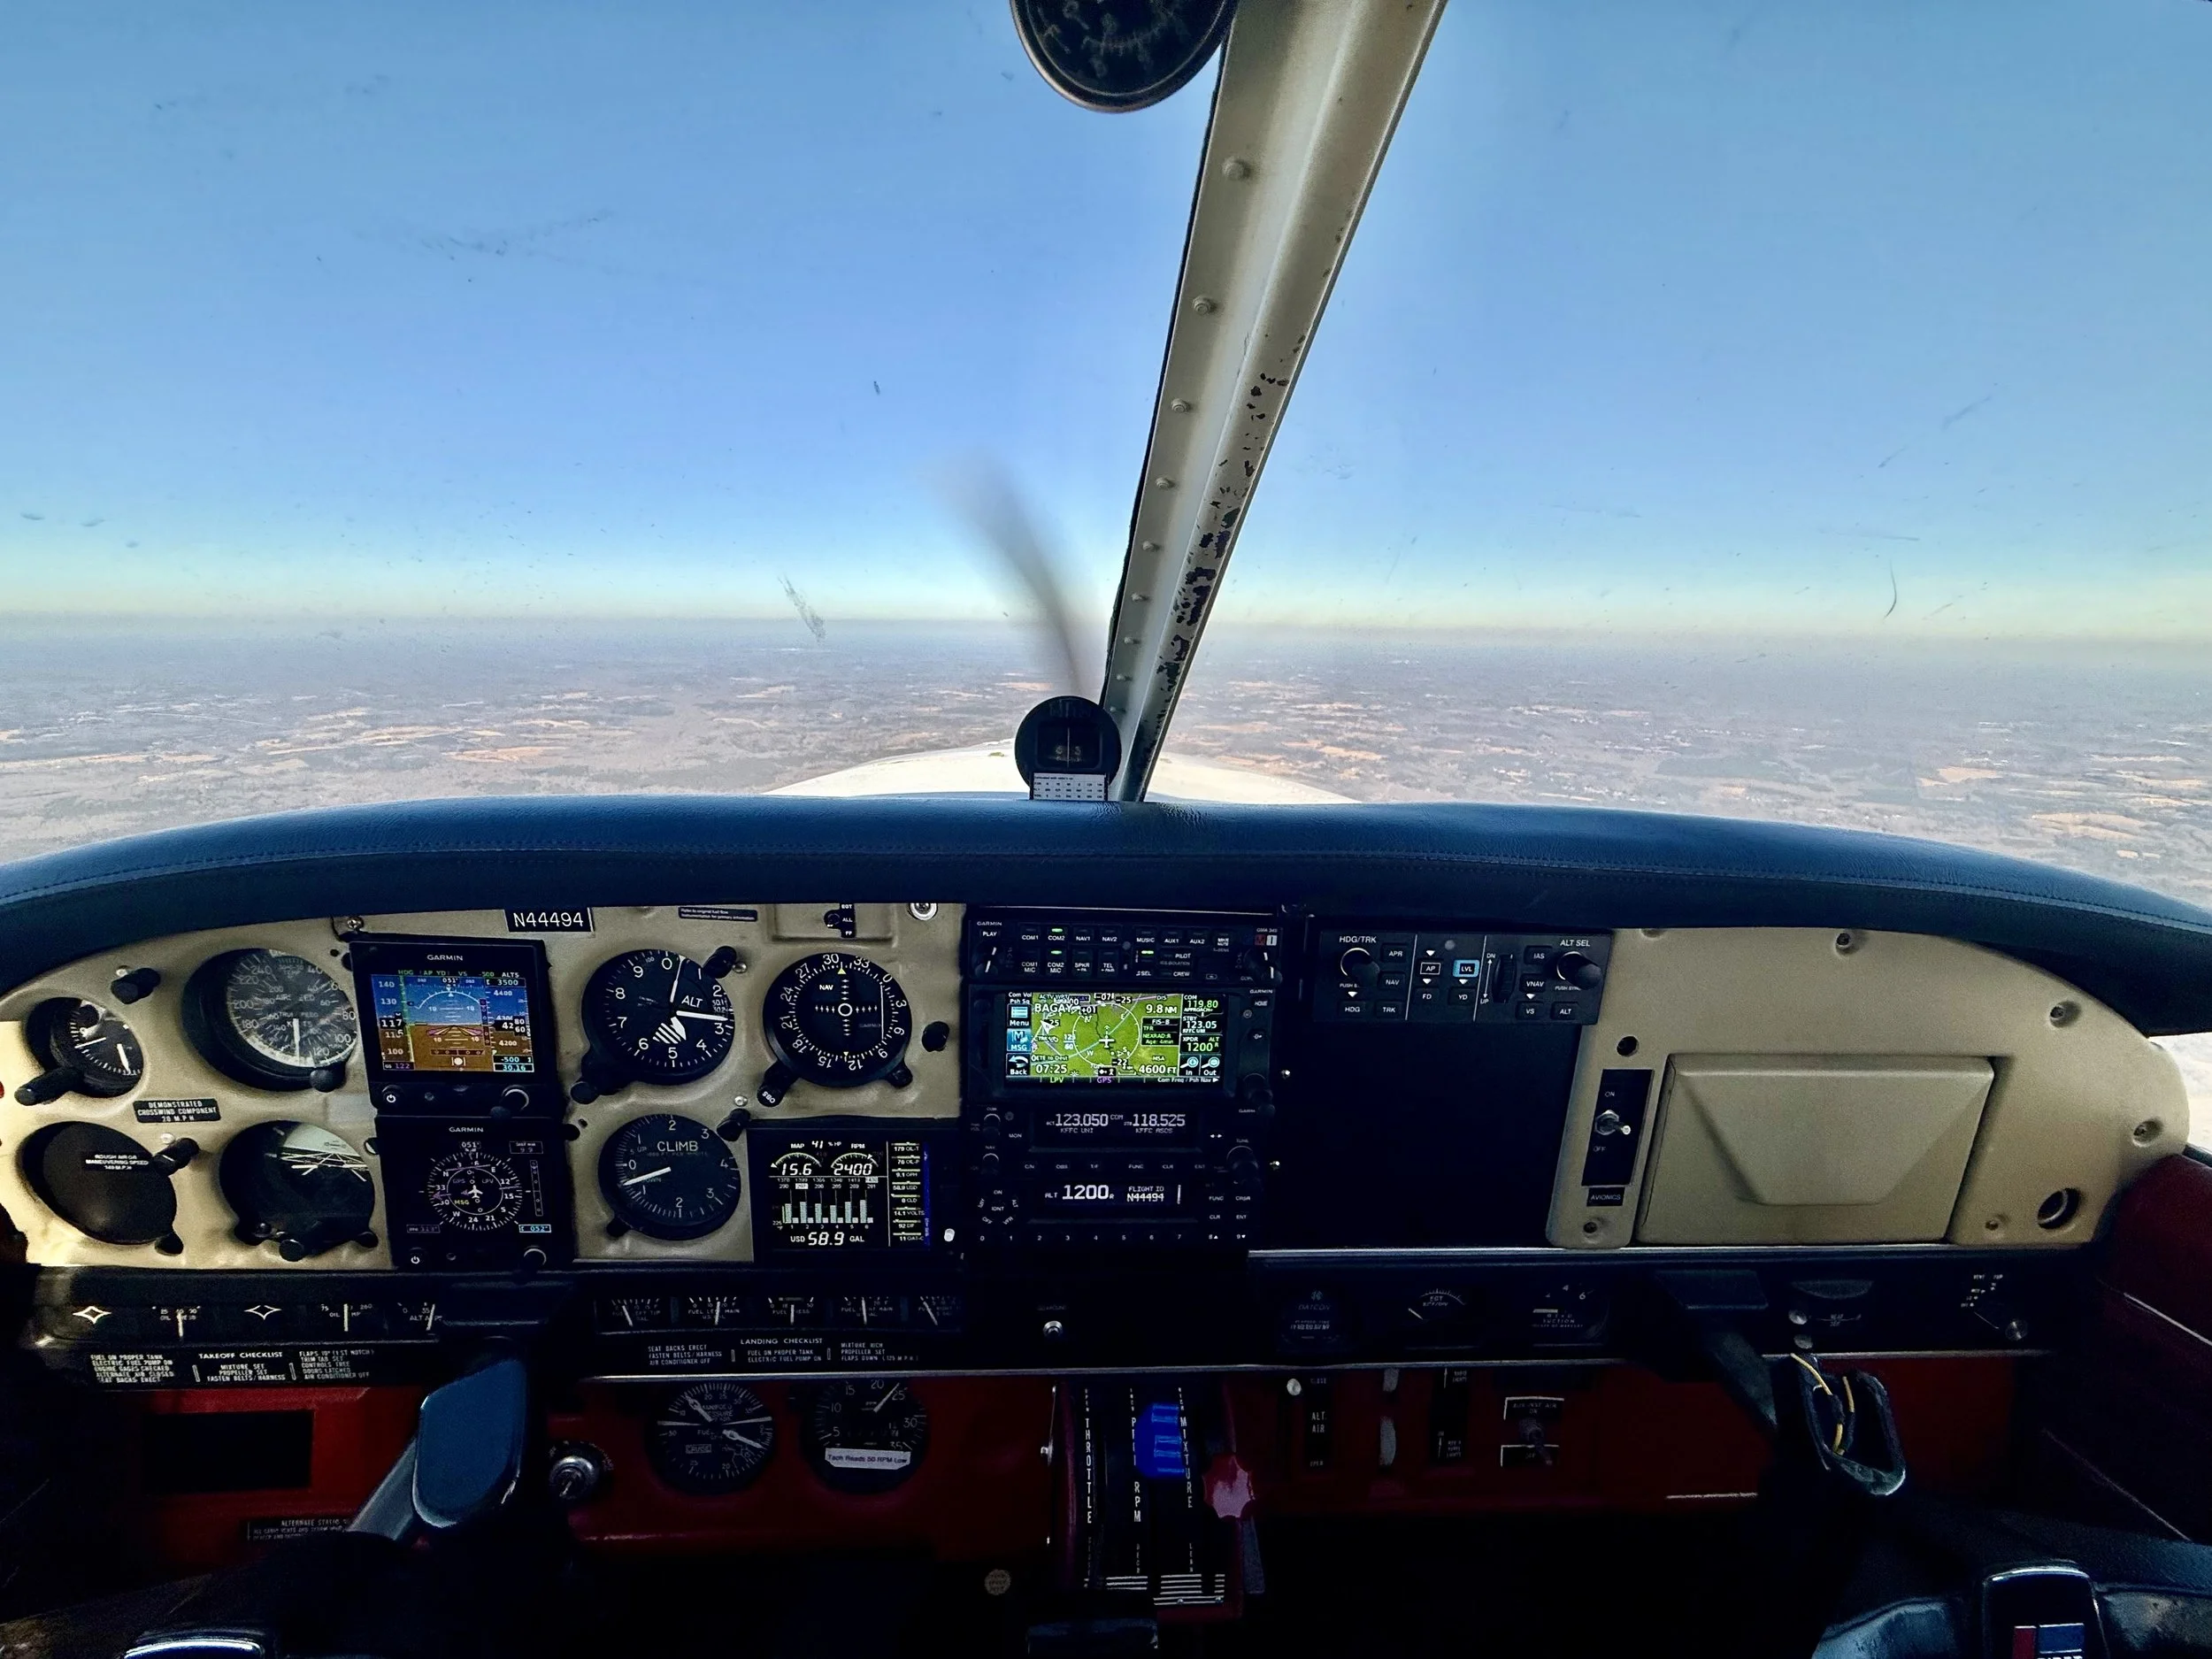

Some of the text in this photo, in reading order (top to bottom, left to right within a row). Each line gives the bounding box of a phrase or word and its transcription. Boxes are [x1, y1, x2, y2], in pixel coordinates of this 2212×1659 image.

[513, 912, 584, 927] N44494
[662, 958, 672, 970] 0
[823, 954, 839, 964] 30
[854, 956, 871, 968] 33
[634, 966, 643, 978] 9
[795, 964, 810, 978] 27
[615, 987, 626, 999] 8
[712, 985, 722, 996] 2
[780, 987, 794, 1002] 24
[681, 995, 703, 1008] ALT
[1146, 1004, 1163, 1013] 9.8
[618, 1017, 627, 1028] 7
[781, 1016, 793, 1029] 21
[715, 1023, 724, 1034] 3
[639, 1038, 649, 1049] 6
[696, 1040, 706, 1050] 4
[792, 1040, 808, 1054] 18
[668, 1047, 678, 1058] 5
[818, 1056, 832, 1068] 15
[848, 1059, 864, 1071] 12
[1036, 1064, 1067, 1073] 07:25
[1139, 1065, 1165, 1074] 4600
[762, 1091, 776, 1103] OBS
[669, 1120, 676, 1131] 2
[1056, 1114, 1109, 1126] 123.050
[1133, 1114, 1186, 1126] 118.525
[701, 1129, 710, 1139] 3
[657, 1141, 699, 1151] CLIMB
[628, 1160, 636, 1170] 0
[781, 1164, 812, 1176] 15.6
[833, 1164, 872, 1176] 2400
[706, 1188, 714, 1198] 3
[1062, 1185, 1110, 1200] 1200
[1126, 1194, 1164, 1202] N44494
[676, 1198, 683, 1207] 2
[808, 1232, 844, 1246] 58.9
[845, 1385, 856, 1395] 15
[870, 1379, 884, 1390] 20
[892, 1391, 905, 1401] 25
[831, 1403, 841, 1413] 10
[1311, 1412, 1326, 1421] ALT
[903, 1417, 918, 1428] 30
[833, 1428, 840, 1437] 5
[1312, 1425, 1325, 1433] AIR
[1180, 1417, 1193, 1509] MIXTURE
